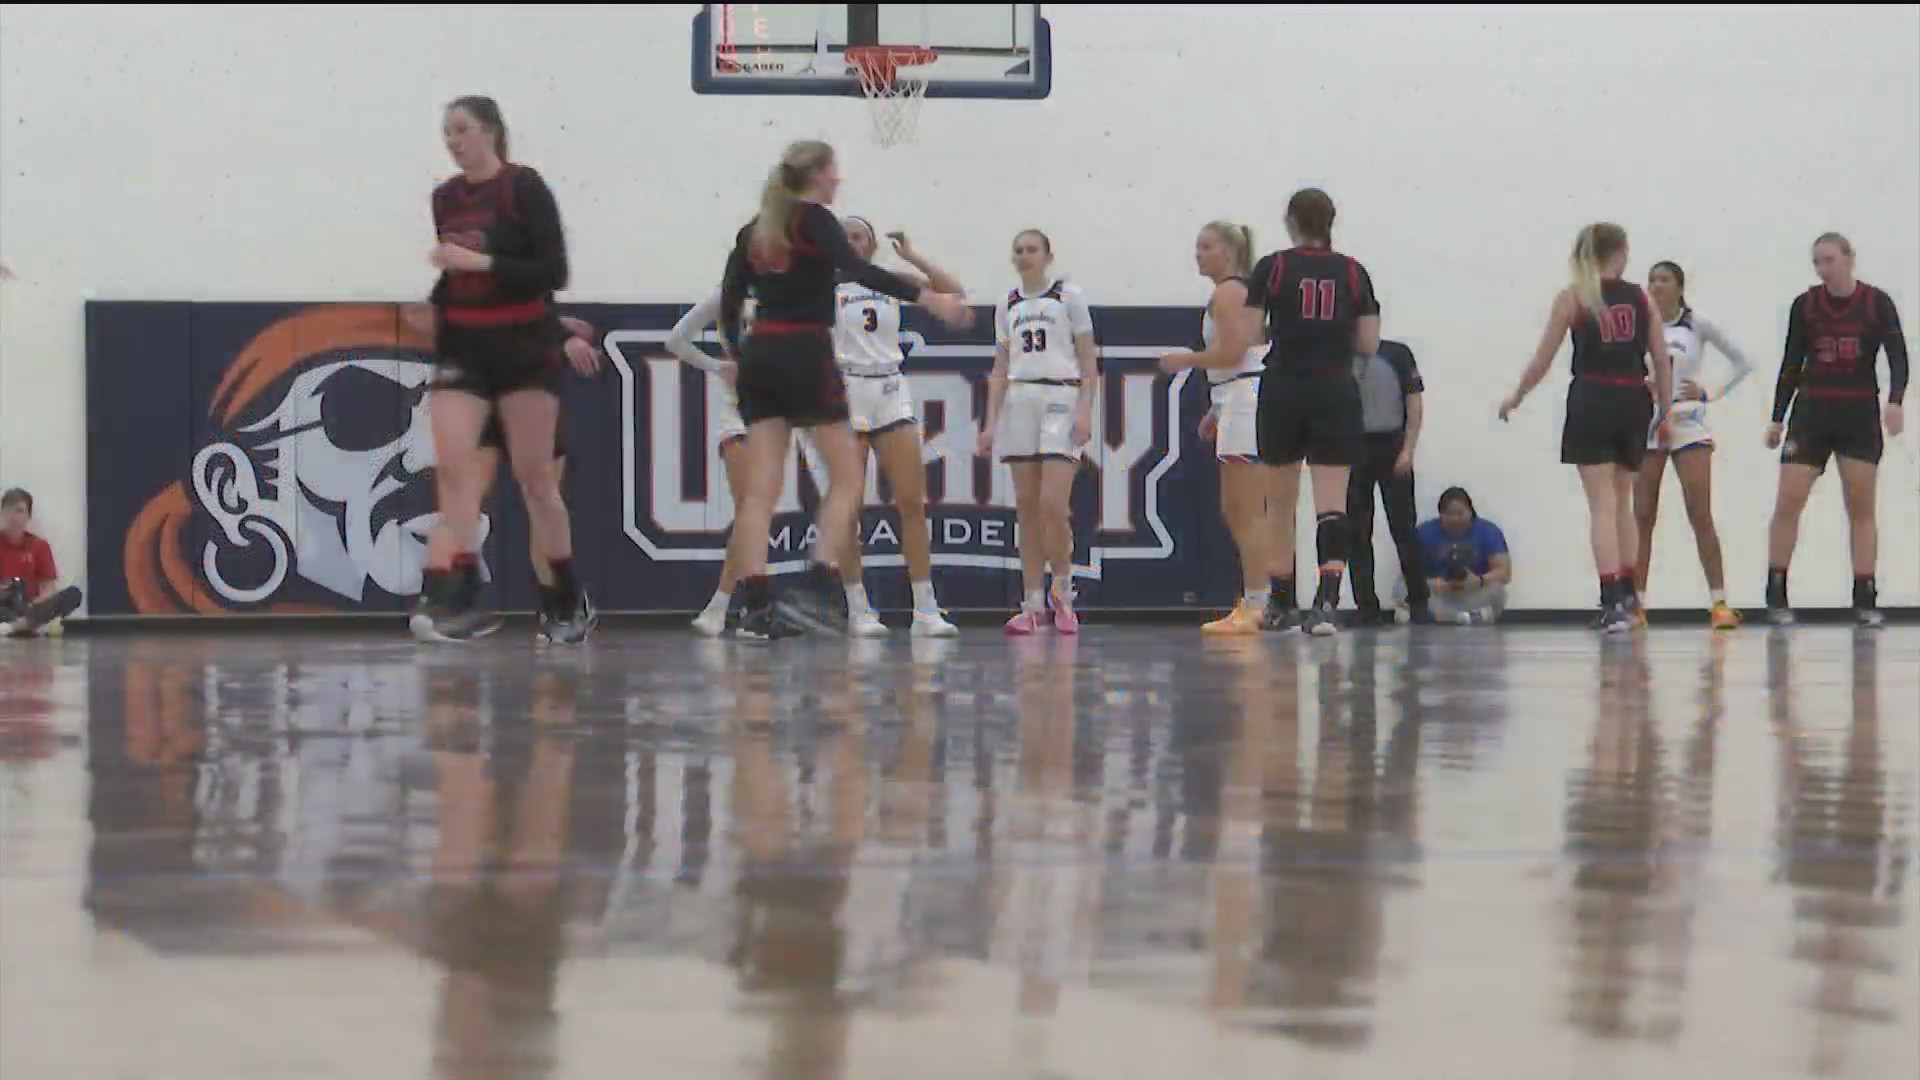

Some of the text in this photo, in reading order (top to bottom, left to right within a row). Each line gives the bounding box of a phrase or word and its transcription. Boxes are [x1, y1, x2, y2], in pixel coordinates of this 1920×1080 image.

[1298, 277, 1336, 321] 11
[862, 307, 878, 333] 3
[1021, 328, 1047, 353] 33
